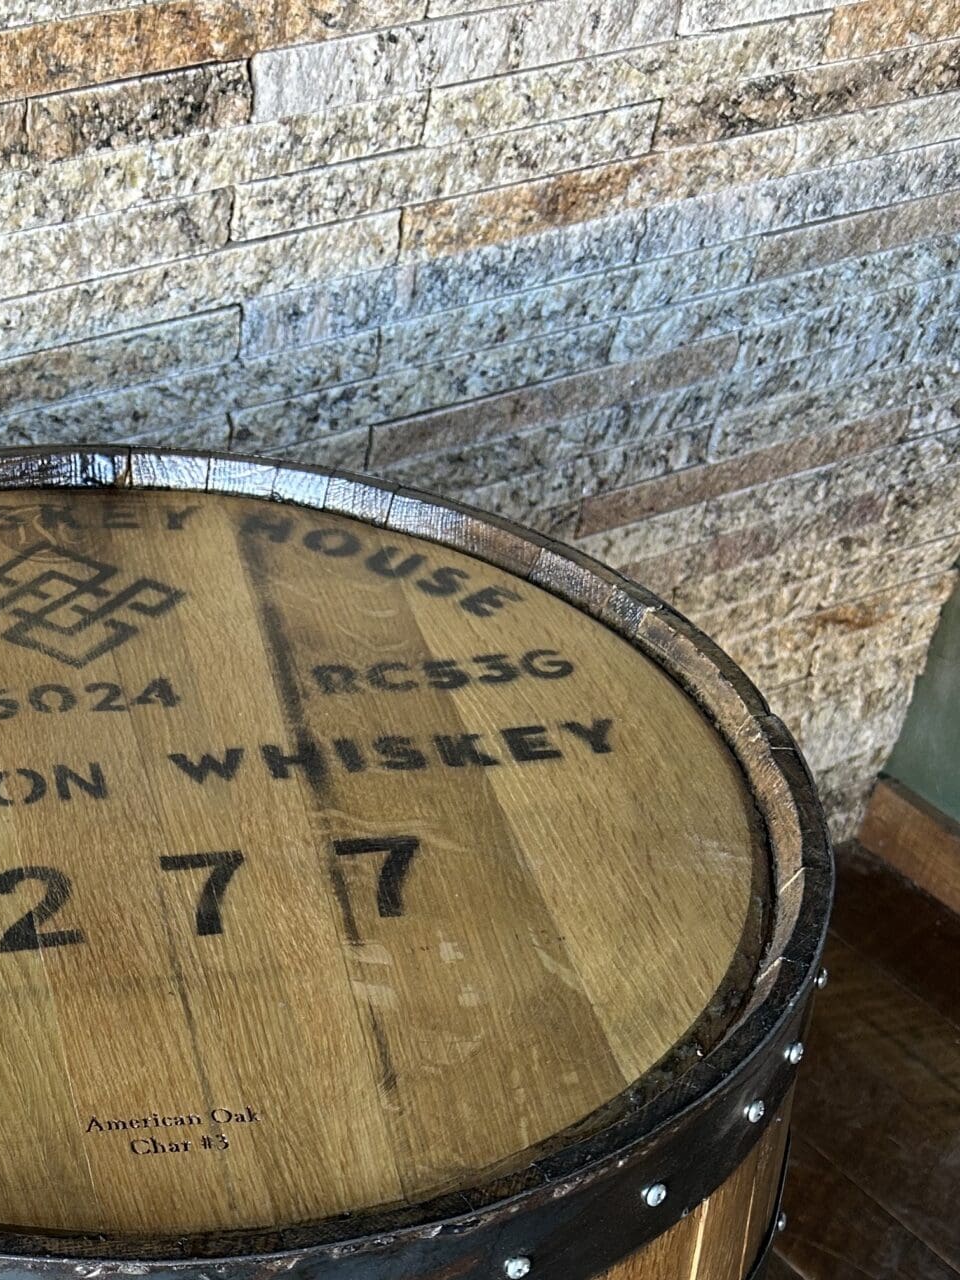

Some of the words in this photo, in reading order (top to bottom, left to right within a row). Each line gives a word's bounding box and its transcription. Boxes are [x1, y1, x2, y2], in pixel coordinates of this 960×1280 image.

[240, 508, 525, 617] HOUSE
[311, 647, 574, 694] RC53G
[169, 717, 614, 784] WHISKEY
[86, 1113, 202, 1133] American
[211, 1105, 261, 1124] Oak
[130, 1135, 192, 1155] Char
[201, 1133, 230, 1150] #3
